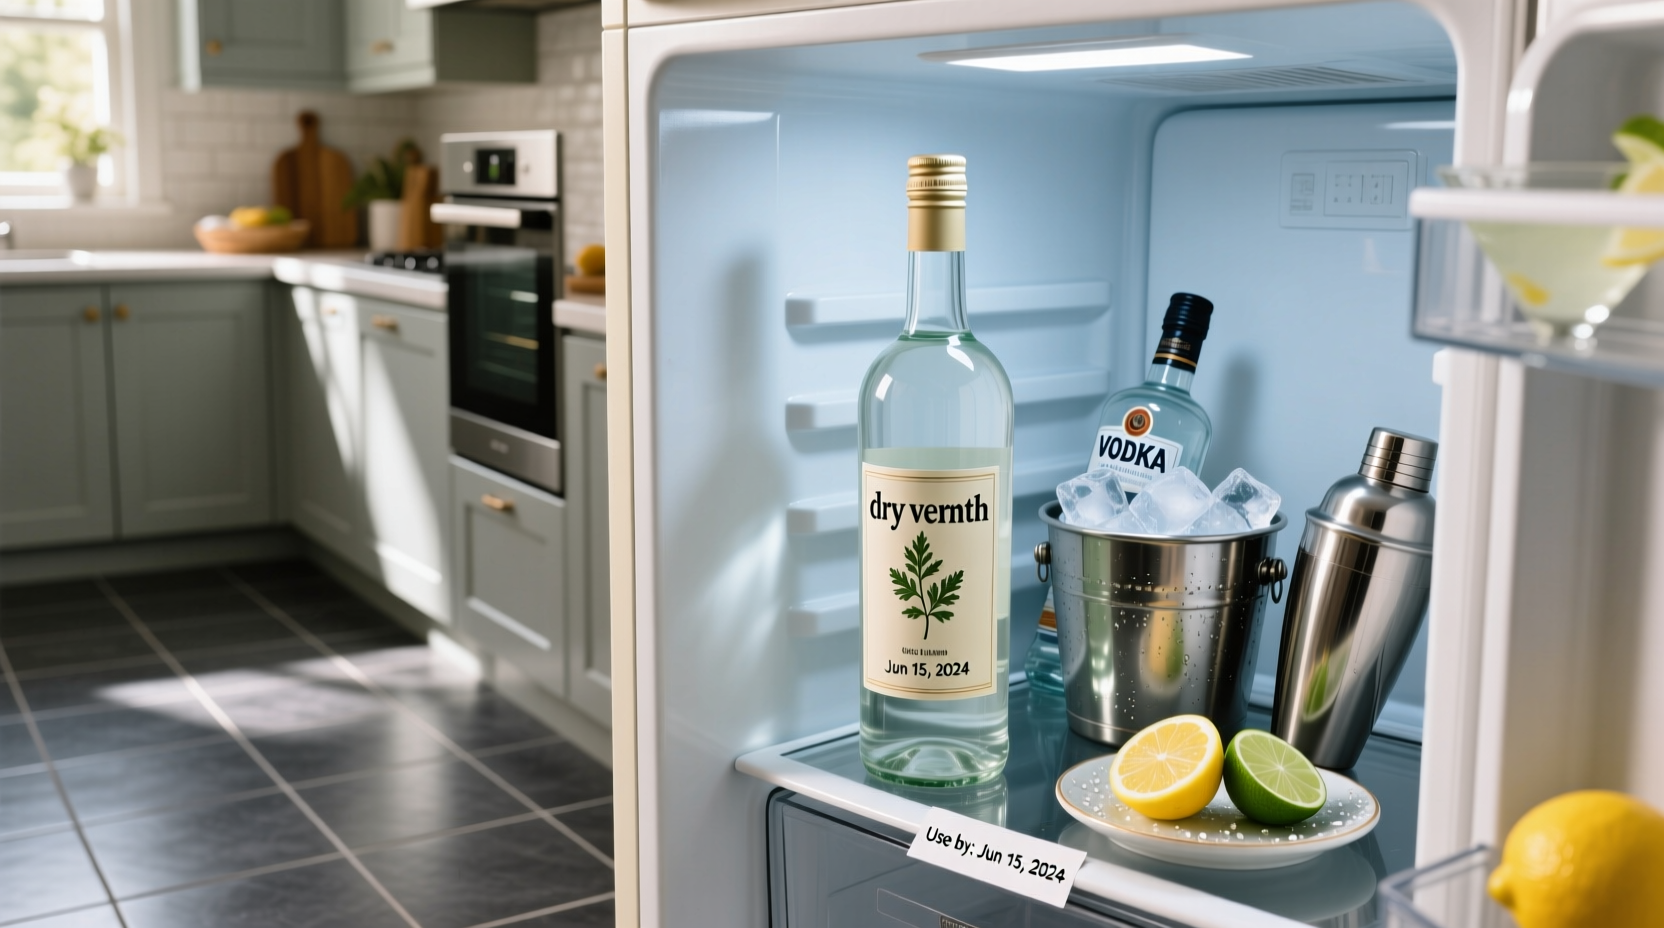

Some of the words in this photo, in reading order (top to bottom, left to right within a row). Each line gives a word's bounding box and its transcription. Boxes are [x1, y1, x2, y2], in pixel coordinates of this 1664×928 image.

[1099, 435, 1166, 474] VODKA
[870, 491, 906, 531] dry
[884, 659, 908, 675] Jun
[912, 662, 932, 679] 15,
[936, 661, 970, 677] 2024
[926, 826, 952, 847] Use
[954, 833, 976, 857] by:
[977, 844, 1003, 864] Jun
[1007, 853, 1025, 874] 15,
[1028, 859, 1066, 884] 2024
